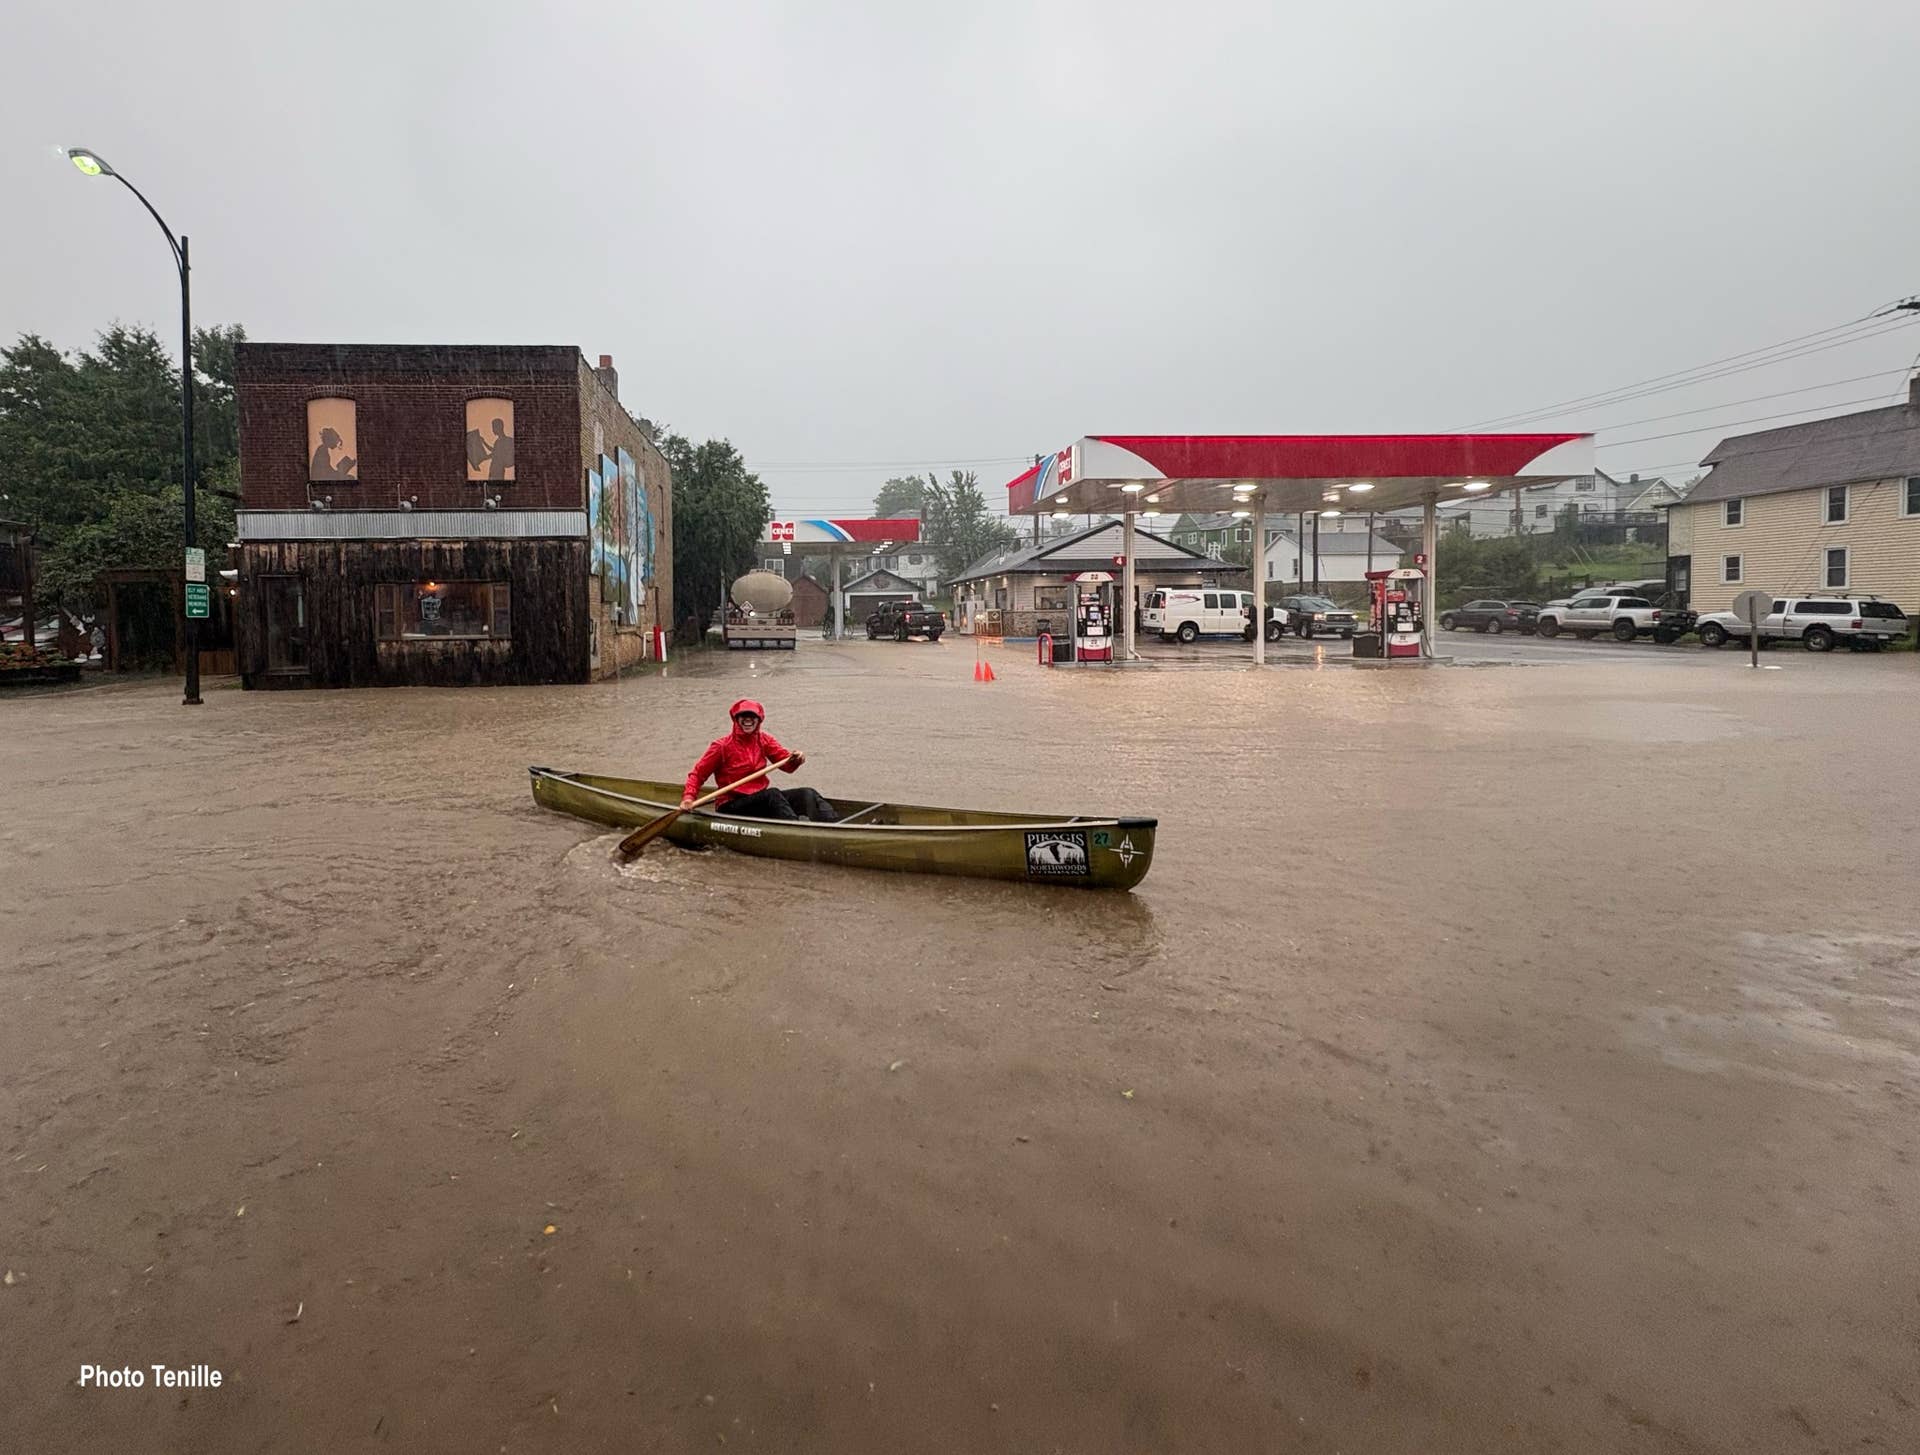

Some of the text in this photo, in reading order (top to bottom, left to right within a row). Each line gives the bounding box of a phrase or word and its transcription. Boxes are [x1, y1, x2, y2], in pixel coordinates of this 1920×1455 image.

[1116, 557, 1122, 565] 4
[1416, 555, 1423, 564] 2
[740, 826, 762, 838] CANOES
[1027, 833, 1085, 847] PIRAGIS
[1094, 832, 1109, 845] 27
